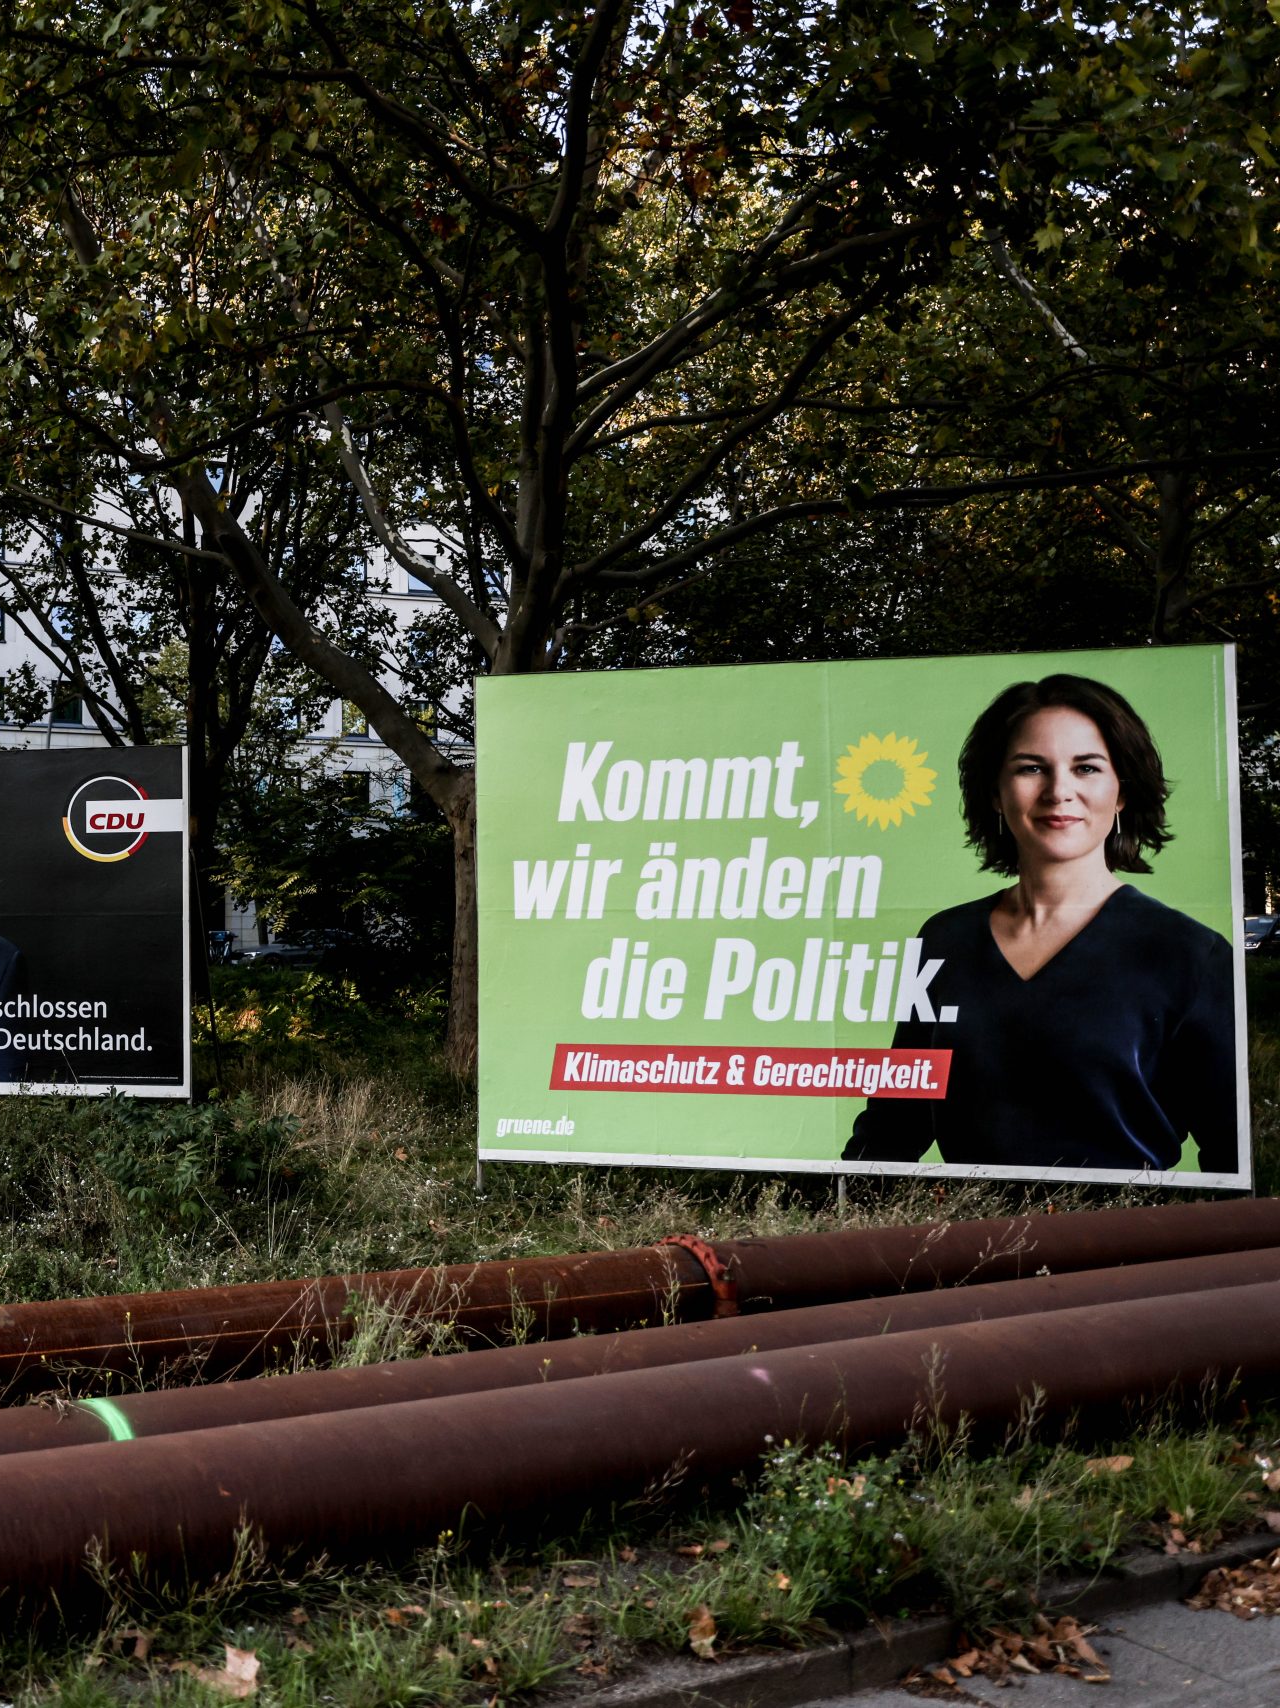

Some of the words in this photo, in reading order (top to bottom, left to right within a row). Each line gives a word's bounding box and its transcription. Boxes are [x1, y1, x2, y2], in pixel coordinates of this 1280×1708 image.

[558, 741, 820, 829] Kommt,
[89, 813, 145, 830] CDU
[513, 843, 623, 919] wir
[635, 837, 883, 920] ändern
[581, 937, 687, 1020] die
[703, 937, 960, 1023] Politik.
[563, 1051, 721, 1085] Klimaschutz
[725, 1054, 746, 1086] &
[752, 1055, 938, 1095] Gerechtigkeit.
[496, 1115, 575, 1138] gruene.de
